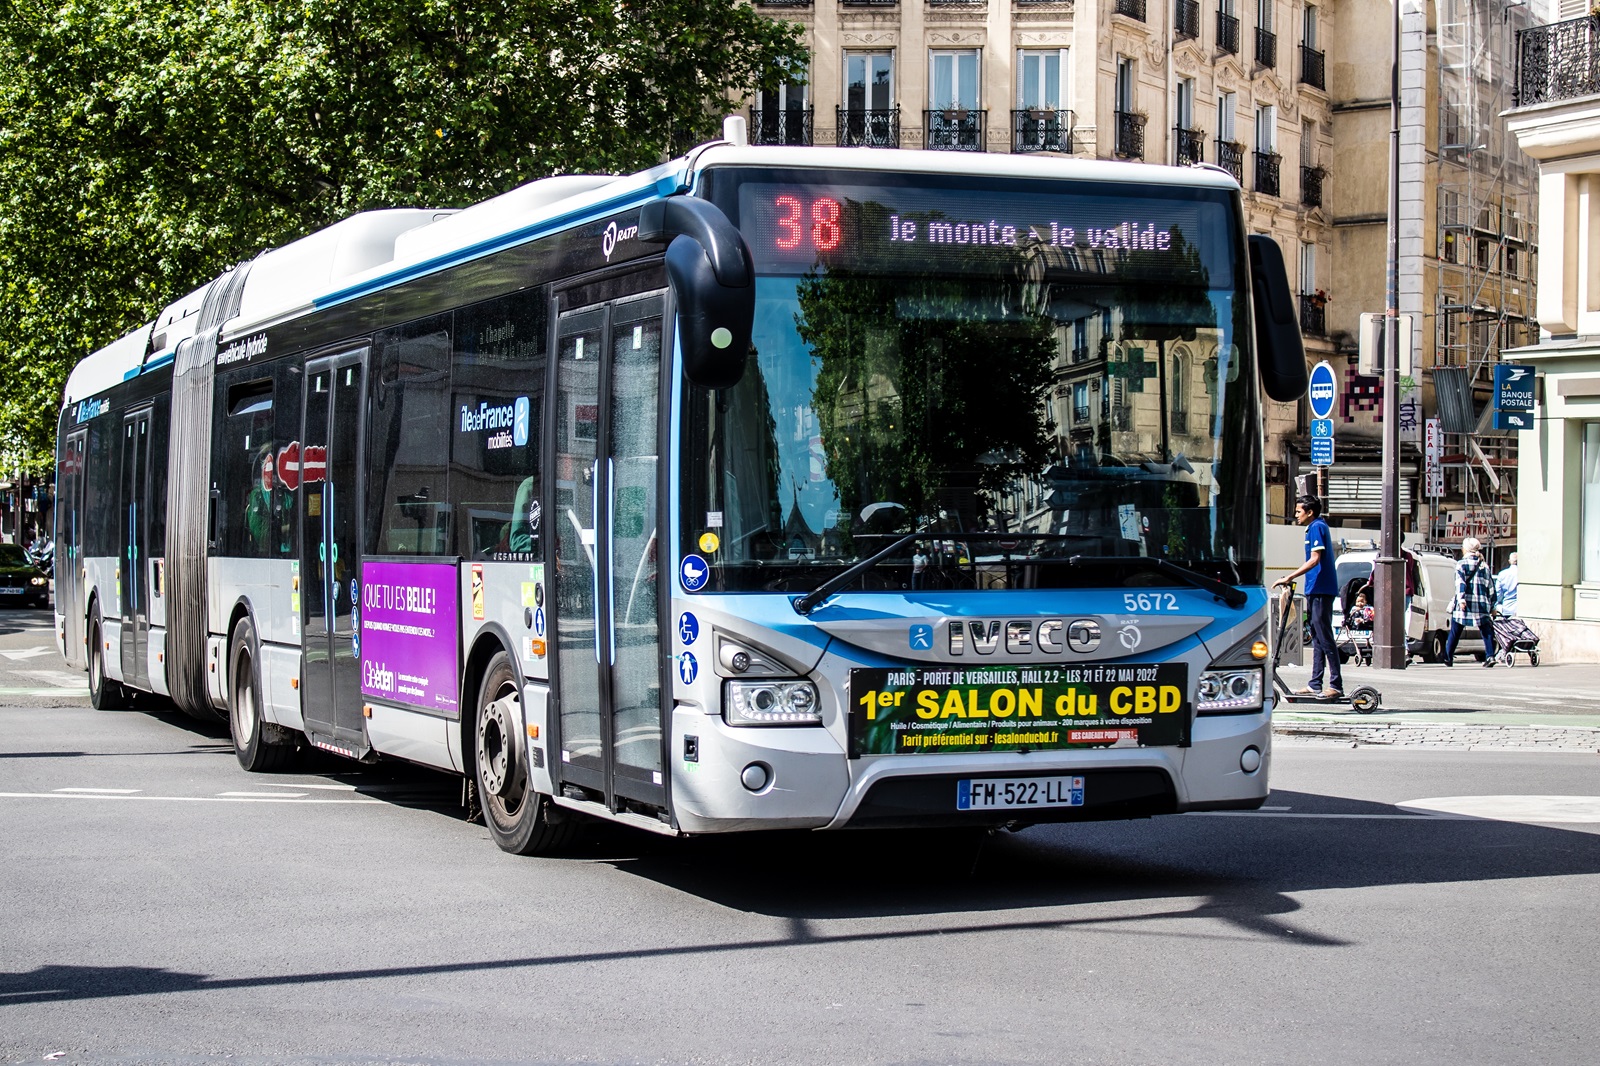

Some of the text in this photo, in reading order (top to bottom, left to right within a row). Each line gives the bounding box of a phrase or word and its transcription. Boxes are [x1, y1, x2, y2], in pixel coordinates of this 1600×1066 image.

[775, 195, 841, 249] 38
[616, 225, 638, 242] RATP
[930, 219, 1016, 246] monte
[1087, 222, 1171, 250] valide
[1501, 391, 1532, 399] BANQUE
[488, 430, 512, 450] mobilités
[364, 583, 381, 612] QUE
[382, 584, 394, 610] TU
[396, 586, 406, 610] ES
[1124, 593, 1180, 612] 5672
[948, 618, 1102, 656] IVECO
[888, 672, 915, 686] PARIS
[924, 672, 951, 686] PORTE
[953, 672, 964, 684] DE
[966, 670, 1020, 685] VERSAILLES,
[1022, 670, 1043, 684] HALL
[1044, 670, 1058, 683] 2.2
[1066, 670, 1081, 683] LES
[1083, 670, 1092, 683] 21
[1095, 669, 1104, 682] ET
[1106, 669, 1116, 682] 22
[1118, 669, 1134, 682] MAI
[1137, 668, 1157, 682] 2022
[860, 685, 1182, 720] 1er SALON du CBD
[912, 722, 948, 730] Cosmétique
[1121, 717, 1152, 726] disposition
[902, 734, 922, 747] Tarif
[924, 733, 973, 747] préférentiel
[975, 735, 988, 745] sur
[994, 732, 1059, 745] lesalonducbd.fr
[1071, 731, 1081, 740] DES
[1082, 731, 1104, 739] CADEAUX
[1105, 730, 1118, 739] POUR
[972, 781, 1068, 805] FM-522-LL
[1072, 790, 1082, 800] 75
